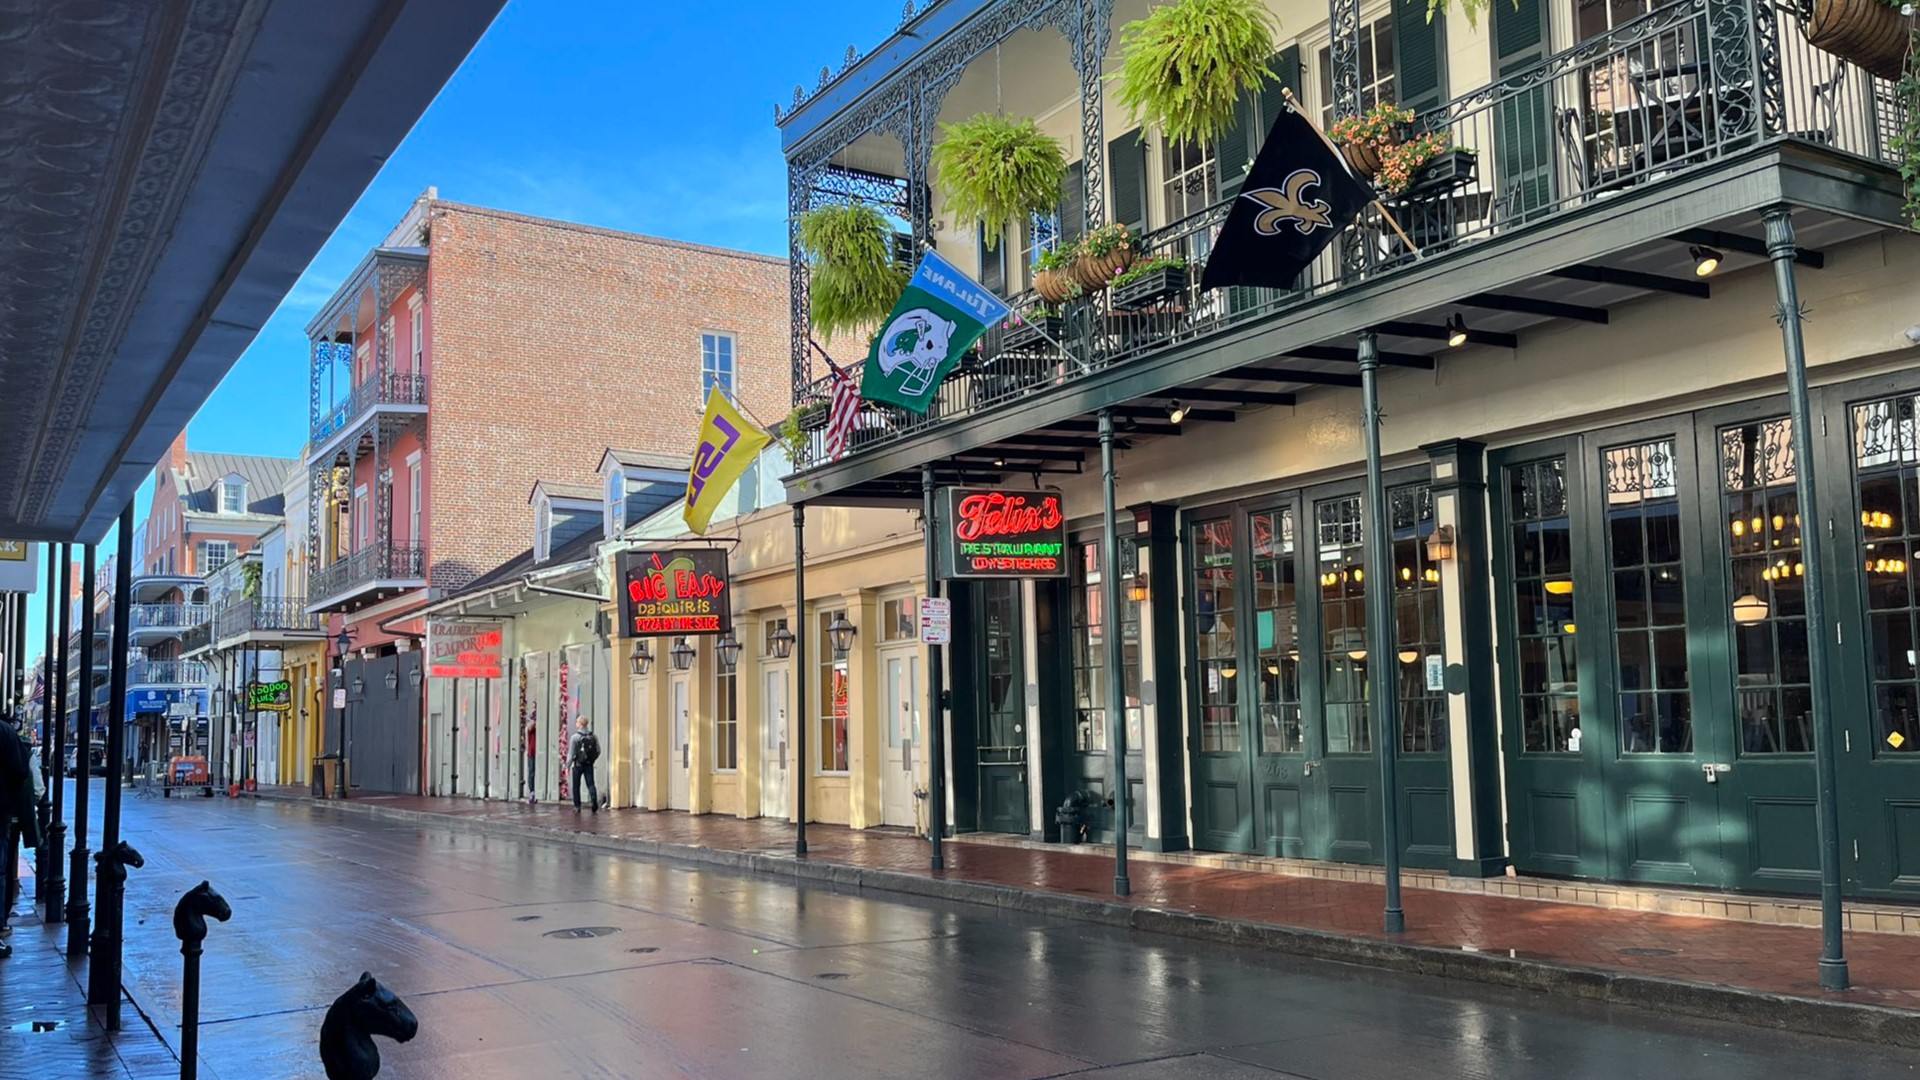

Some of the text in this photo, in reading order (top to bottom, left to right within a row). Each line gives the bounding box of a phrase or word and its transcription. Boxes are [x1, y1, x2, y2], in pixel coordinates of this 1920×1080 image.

[956, 492, 1063, 542] Felix's
[960, 542, 1063, 556] RESTAURANT
[629, 570, 724, 602] BIG EASY
[636, 617, 719, 632] PIZZA BY THE SLICE
